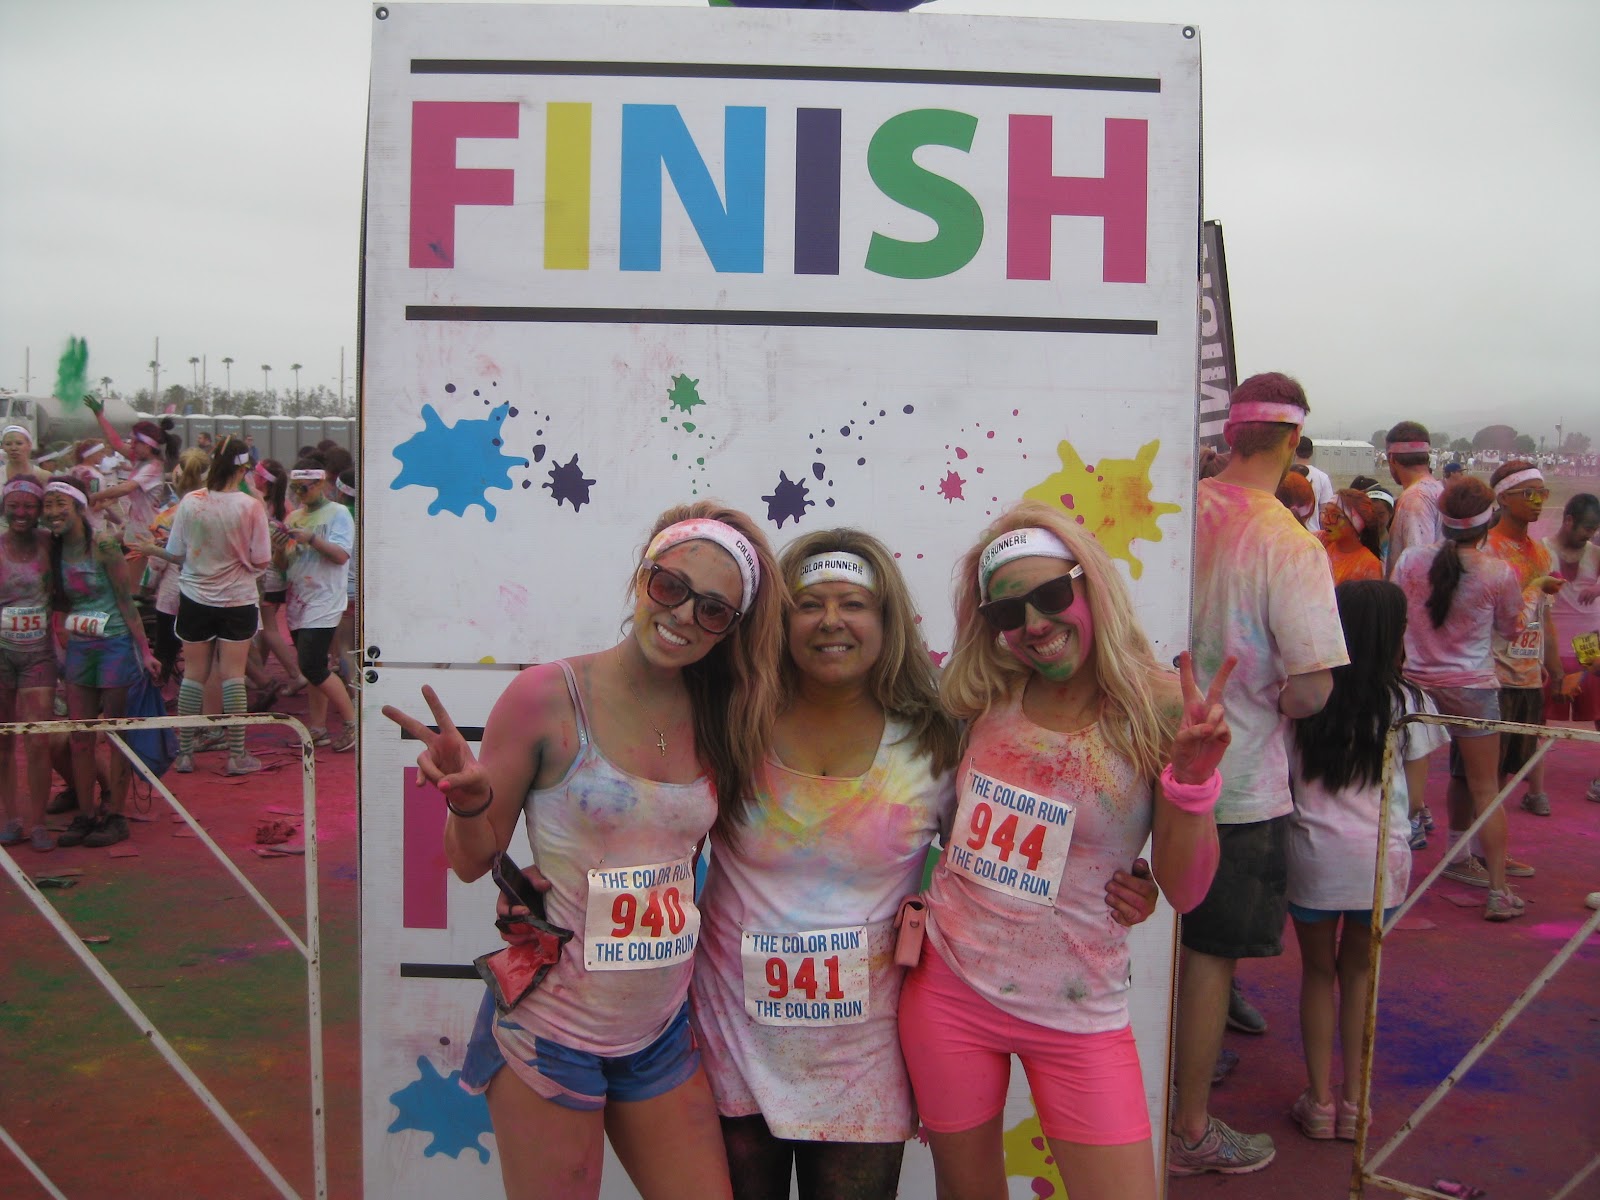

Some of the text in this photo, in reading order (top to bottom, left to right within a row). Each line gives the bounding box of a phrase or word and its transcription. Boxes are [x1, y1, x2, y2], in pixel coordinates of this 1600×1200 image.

[409, 101, 1149, 284] FINISH
[736, 540, 753, 567] COLOR
[990, 535, 1020, 558] RUNNER
[801, 561, 823, 575] COLOR
[825, 560, 857, 573] RUNNER
[11, 615, 41, 632] 135
[73, 614, 98, 634] 140
[971, 774, 1069, 826] THE COLOR RUN
[966, 802, 1047, 871] 944
[599, 872, 628, 889] THE
[632, 866, 671, 889] COLOR
[951, 845, 1051, 897] THE COLOR RUN
[610, 887, 686, 938] 940
[596, 933, 694, 962] THE COLOR RUN
[753, 931, 860, 954] THE COLOR RUN
[765, 955, 845, 1000] 941
[755, 1000, 862, 1020] THE COLOR RUN
